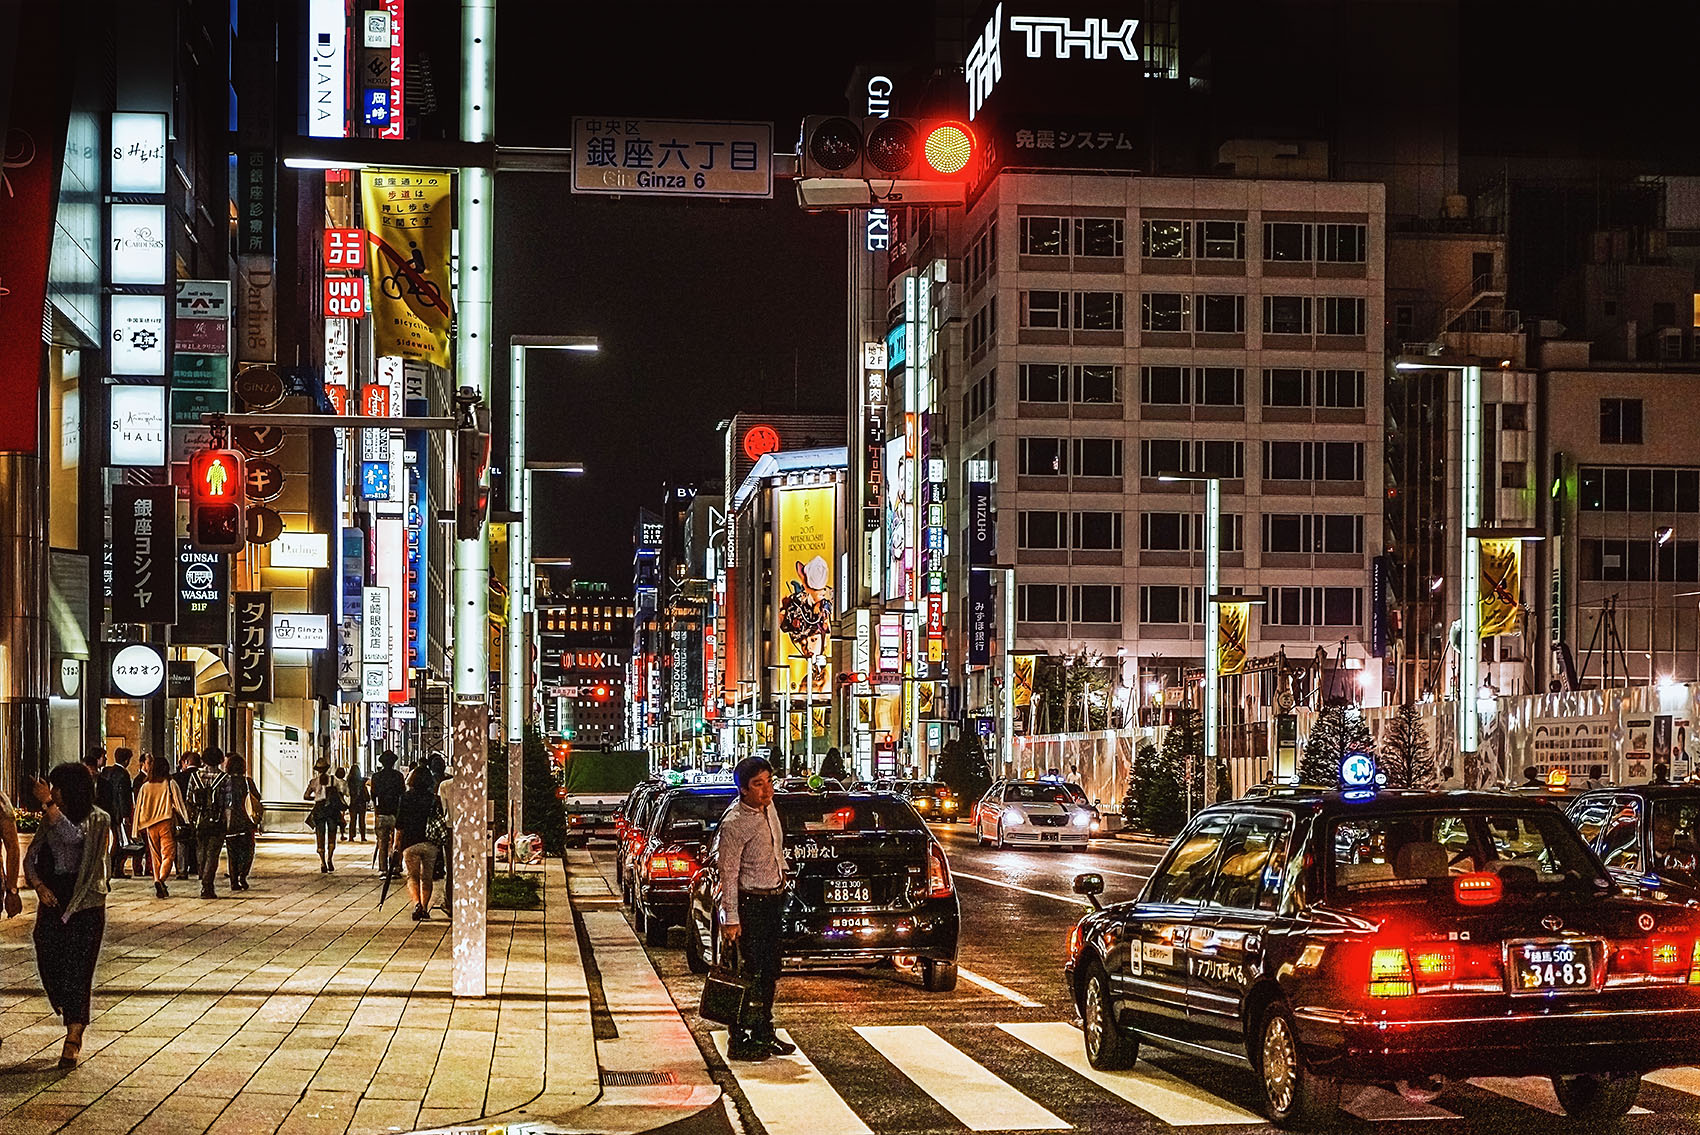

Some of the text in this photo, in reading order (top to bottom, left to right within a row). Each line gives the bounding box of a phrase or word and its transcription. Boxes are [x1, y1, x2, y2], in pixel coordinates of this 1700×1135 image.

[1010, 16, 1139, 60] THK
[586, 120, 640, 135] 中央区
[1015, 129, 1133, 149] 免震システム
[113, 147, 122, 159] 8
[586, 137, 757, 170] 銀座六丁目
[374, 178, 437, 186] 銀座通りの
[637, 171, 705, 188] Ginza 6
[250, 153, 263, 249] 西銀座診療所
[389, 191, 423, 199] 歩道は
[113, 238, 121, 250] 7
[330, 233, 360, 247] ユニ
[329, 250, 360, 263] クロ
[329, 282, 358, 296] UNI
[329, 299, 361, 314] QLO
[113, 329, 122, 341] 6
[870, 356, 883, 365] 2F
[244, 382, 277, 393] GINZA
[112, 421, 119, 430] 5
[124, 432, 162, 441] HALL
[977, 495, 987, 541] MIZUHO
[727, 513, 735, 568] MITSUKOSHI
[133, 498, 152, 608] 銀座ヨシノヤ
[181, 553, 219, 562] GINSAI
[181, 591, 219, 599] WASABI
[975, 602, 985, 651] みずほ銀行
[241, 602, 265, 692] タカゲン
[579, 652, 620, 668] LIXIL
[834, 888, 869, 900] 88-48
[1531, 964, 1587, 986] 34-83
